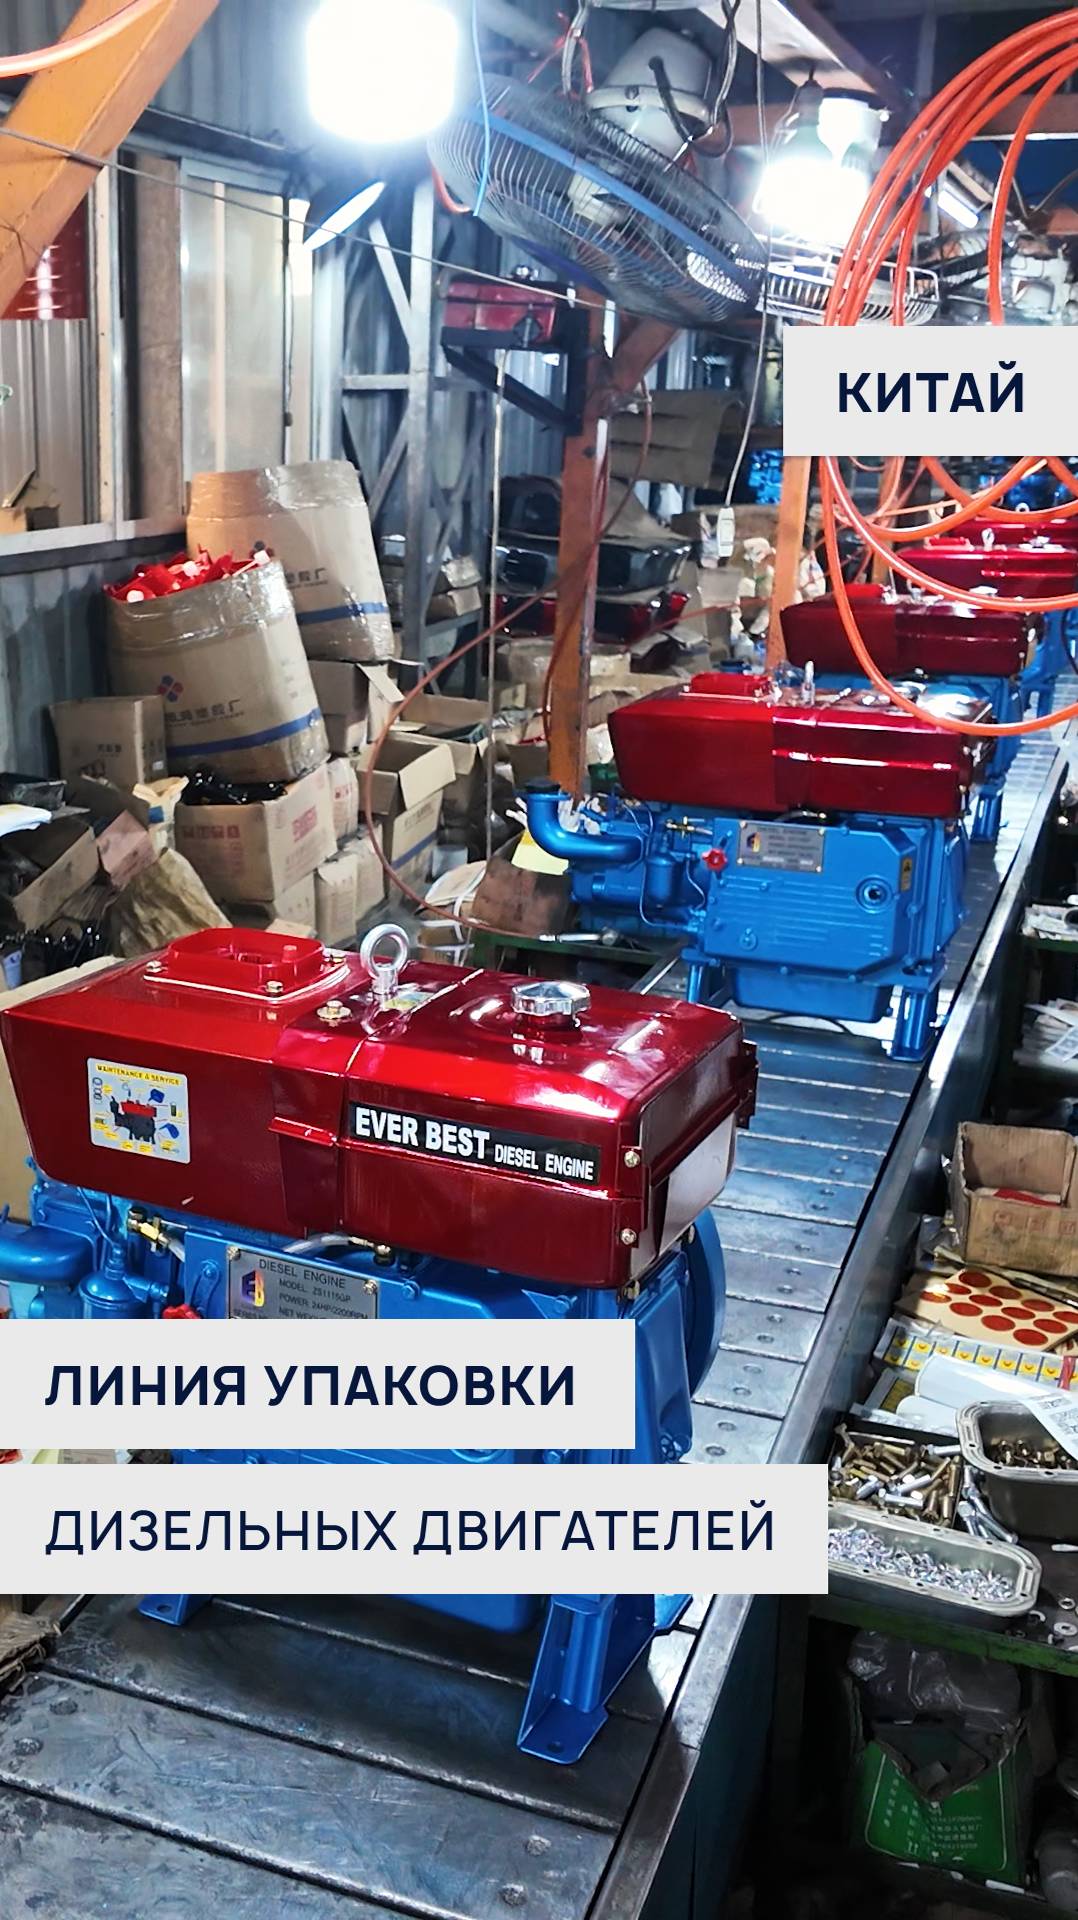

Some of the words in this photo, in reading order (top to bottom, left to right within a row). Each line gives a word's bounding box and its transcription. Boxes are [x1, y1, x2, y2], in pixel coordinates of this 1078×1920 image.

[97, 1065, 142, 1079] MAINTENANCE
[151, 1074, 180, 1086] SERVICE
[355, 1106, 419, 1147] EVER
[425, 1120, 490, 1160] BEST
[494, 1143, 539, 1170] DIESEL
[545, 1153, 594, 1181] ENGINE
[259, 1259, 298, 1277] DIESEL
[303, 1270, 346, 1289] ENGINE
[278, 1307, 294, 1318] NET
